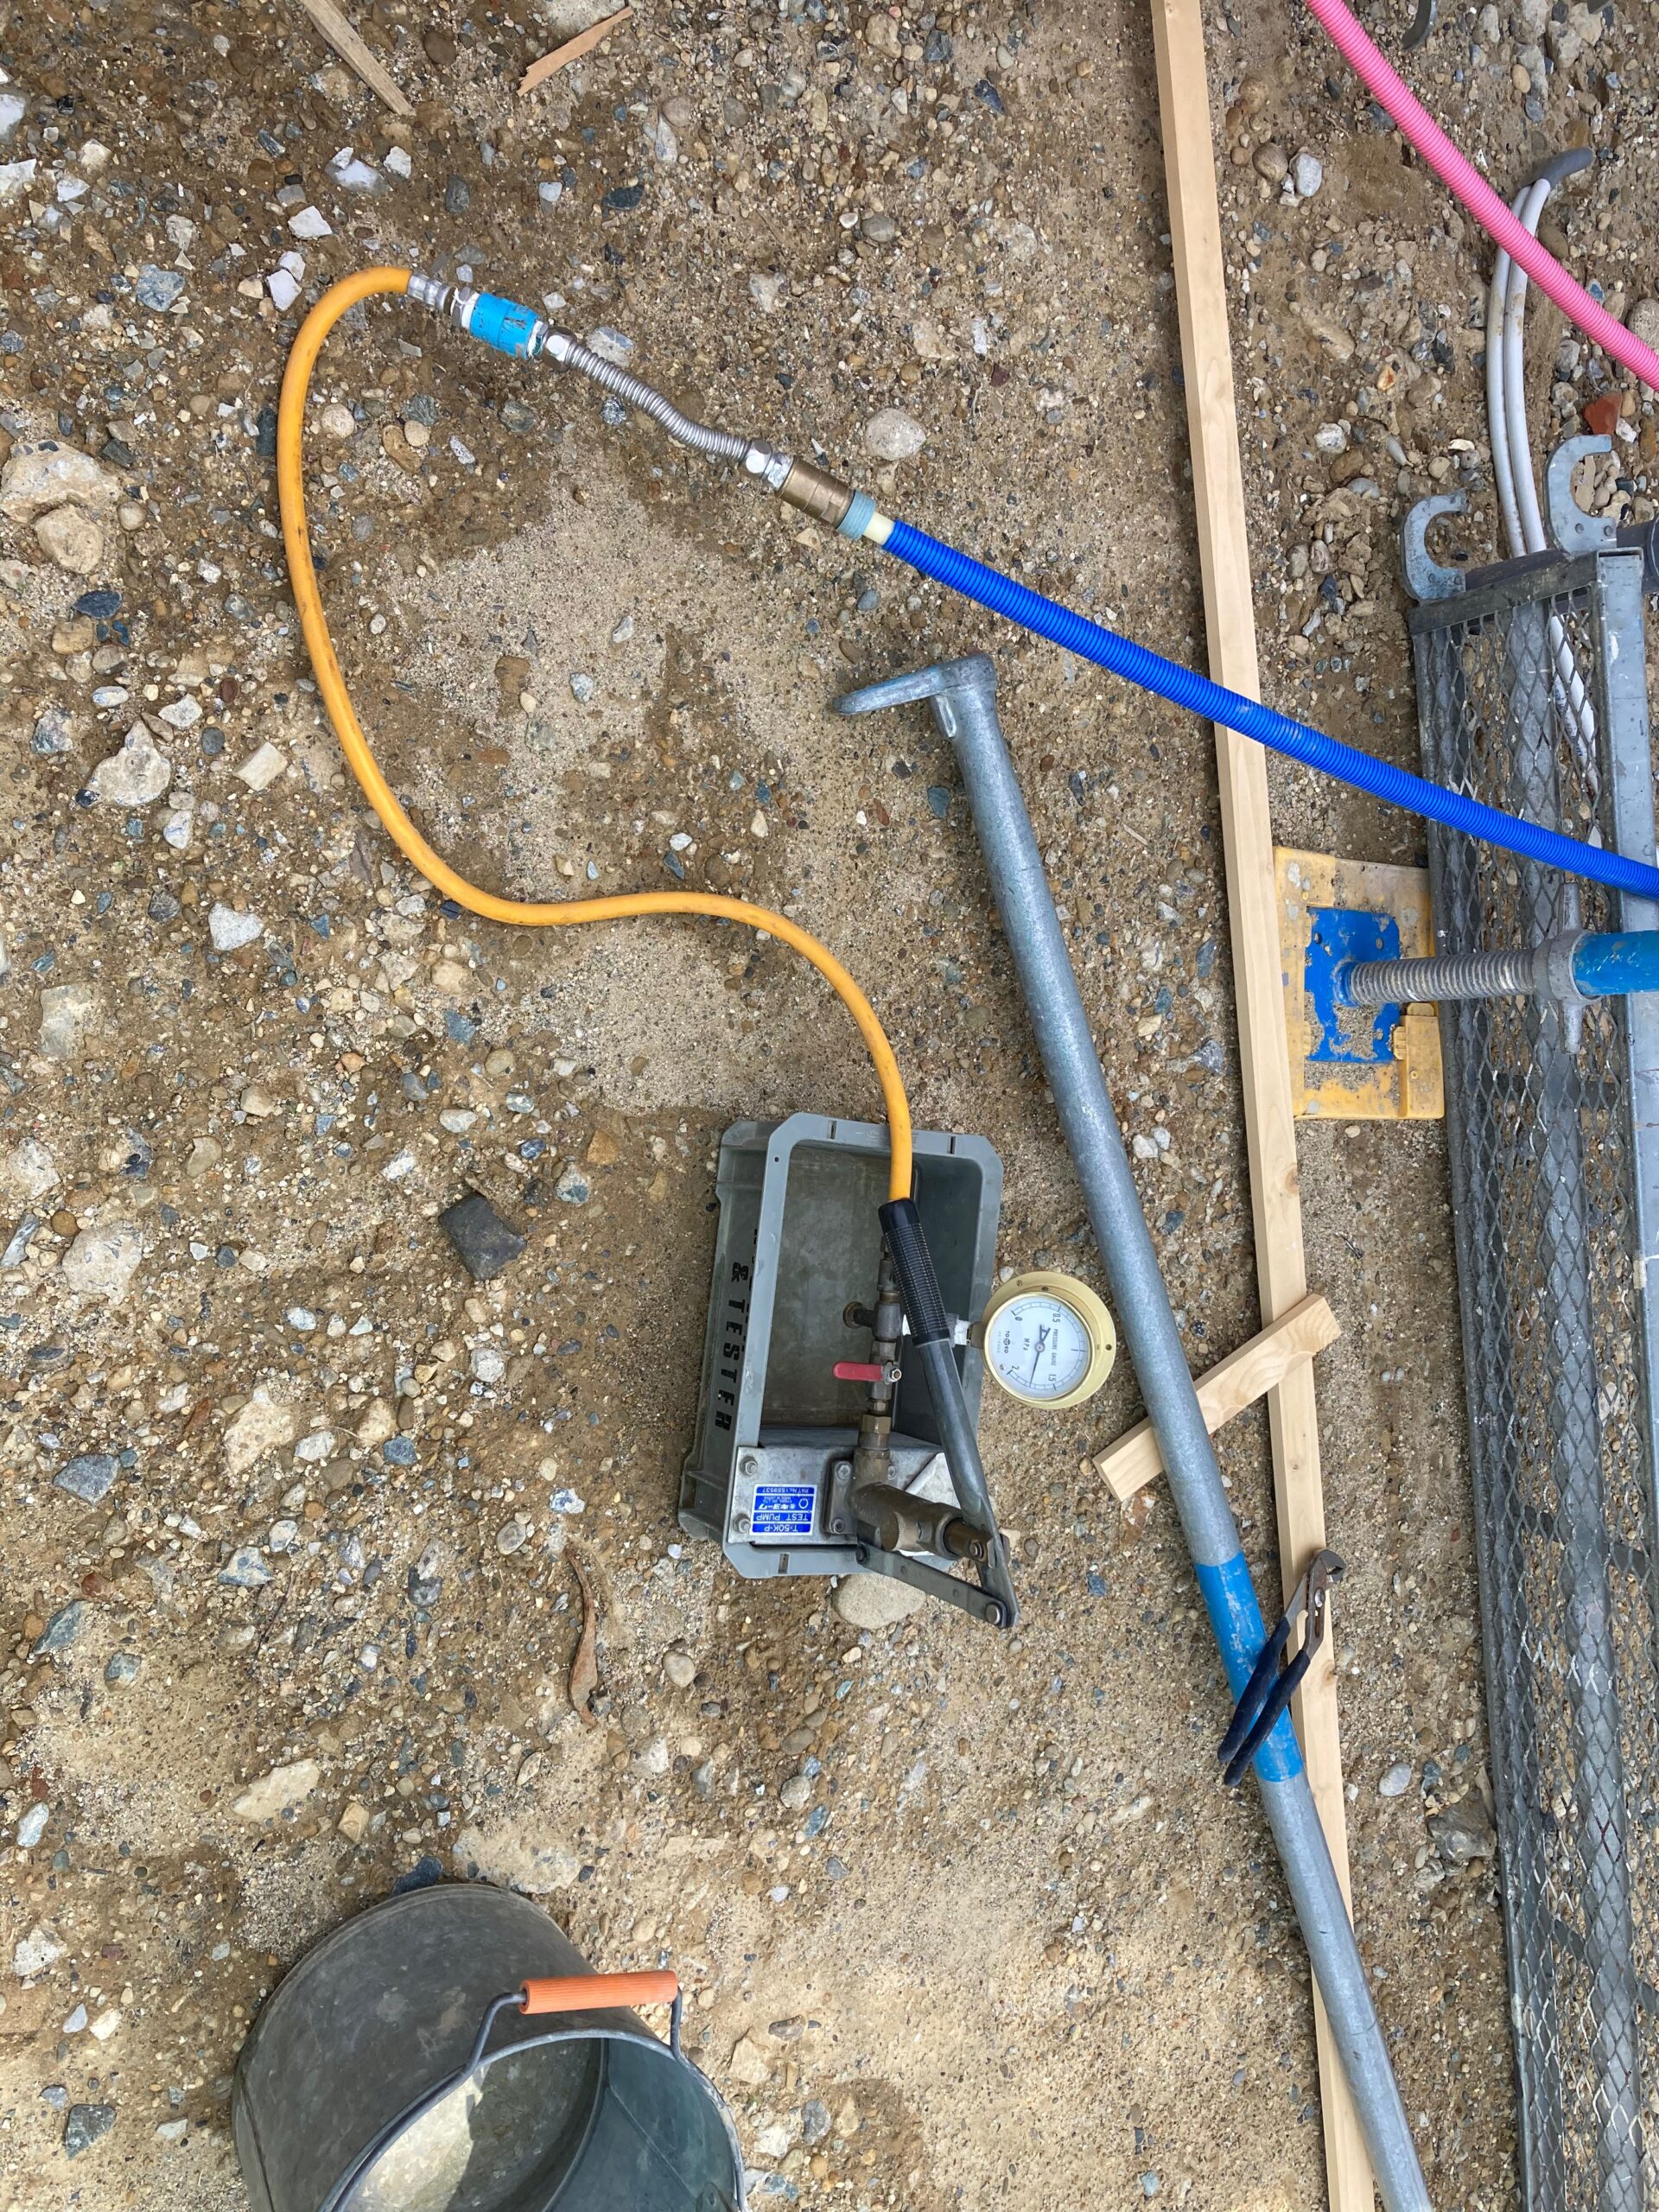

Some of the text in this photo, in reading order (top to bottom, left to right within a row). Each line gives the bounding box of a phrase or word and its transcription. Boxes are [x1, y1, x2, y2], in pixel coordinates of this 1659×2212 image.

[715, 1261, 749, 1432] & TESTER
[1052, 1313, 1061, 1323] 0.5
